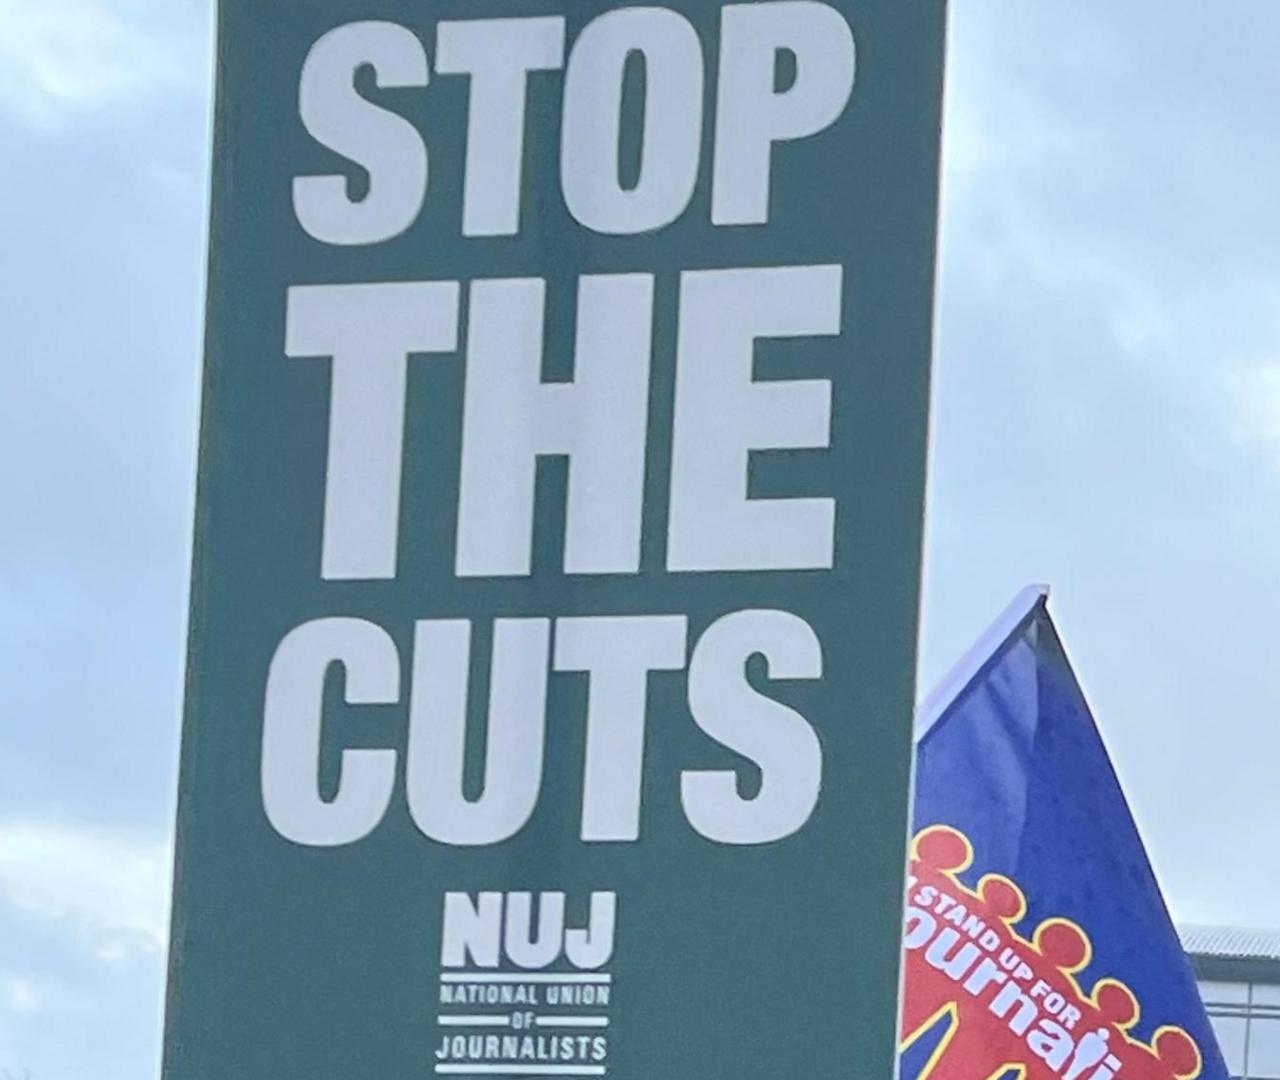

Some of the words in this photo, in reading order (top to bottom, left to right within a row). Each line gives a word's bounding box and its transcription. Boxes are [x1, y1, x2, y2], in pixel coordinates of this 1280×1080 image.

[293, 0, 856, 245] STOP
[284, 264, 843, 580] THE
[260, 609, 823, 846] CUTS
[441, 892, 616, 969] NUJ
[914, 885, 1001, 952] STAND
[998, 947, 1034, 982] UP
[1030, 979, 1082, 1030] FOR
[435, 1035, 607, 1061] JOURNALISTS
[440, 984, 538, 1005] NATIONAL
[547, 984, 610, 1005] UNION
[511, 1011, 535, 1030] OF
